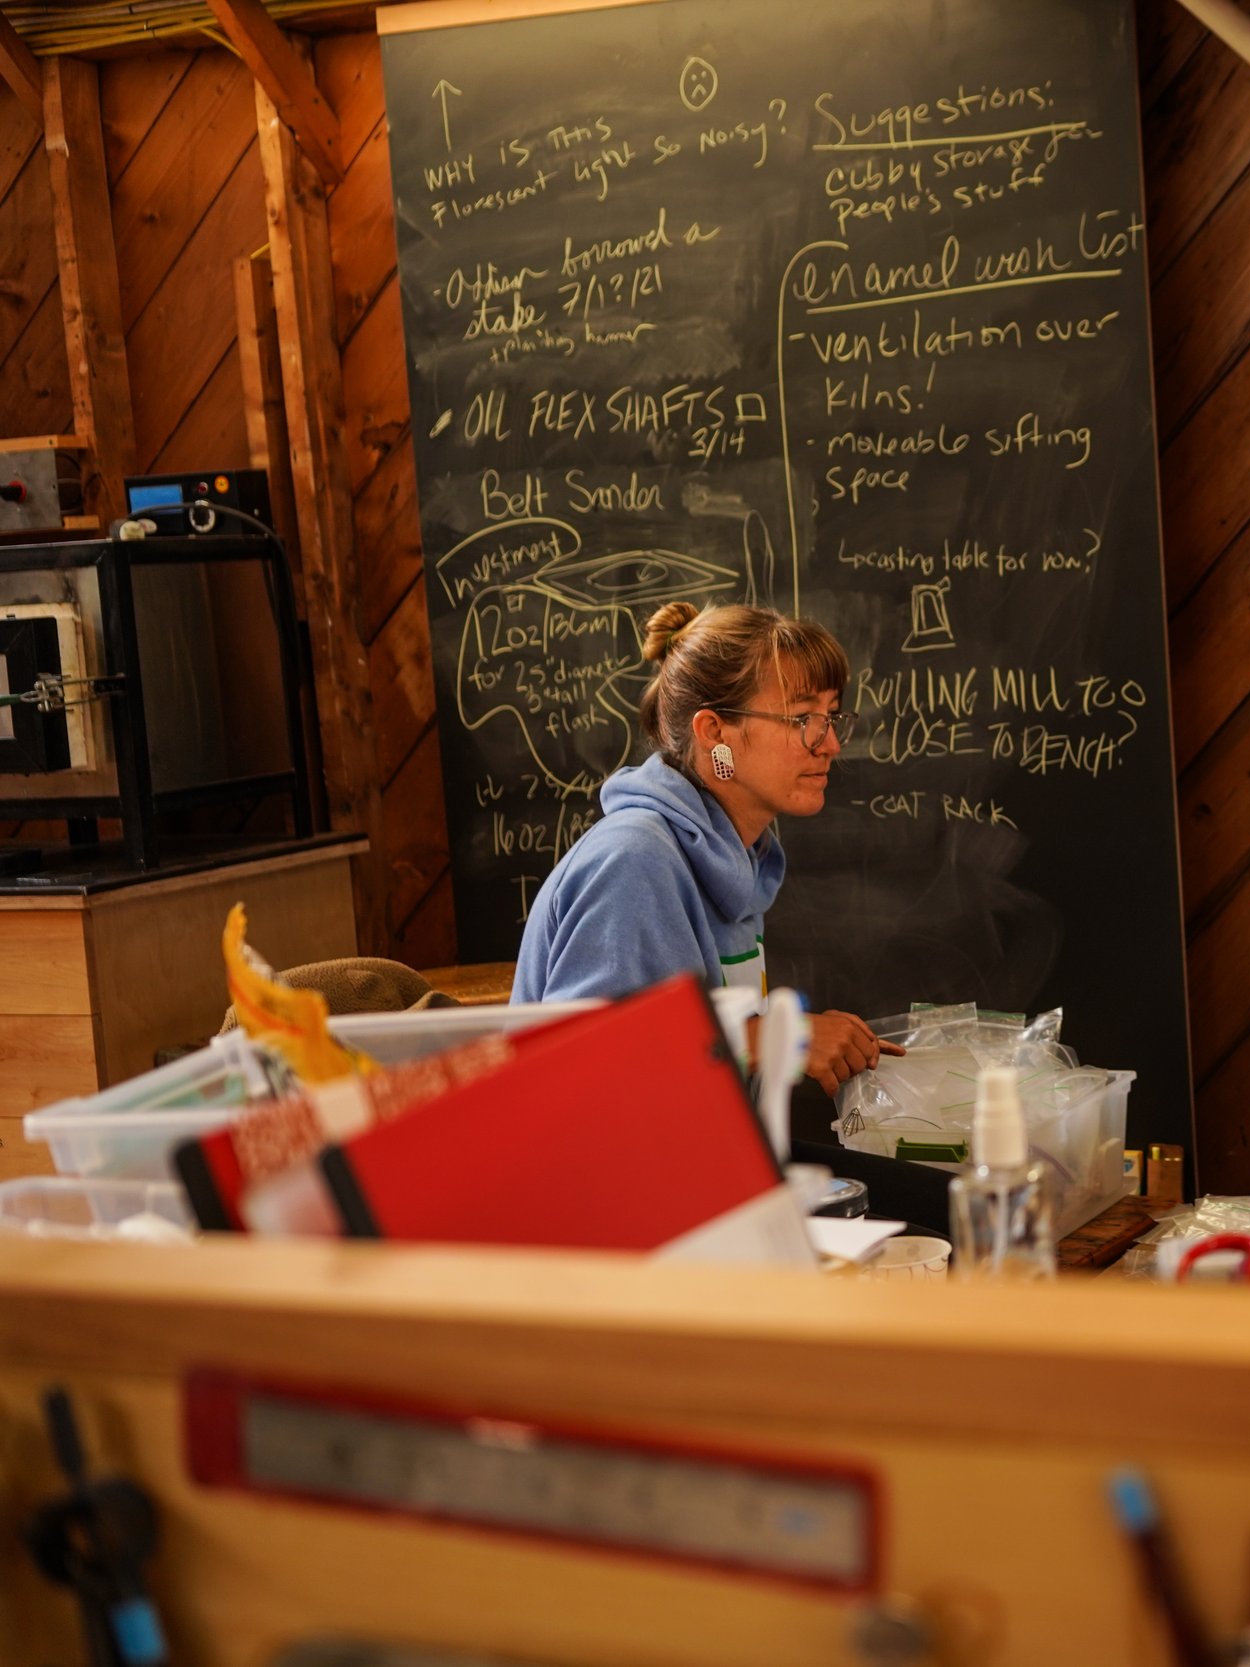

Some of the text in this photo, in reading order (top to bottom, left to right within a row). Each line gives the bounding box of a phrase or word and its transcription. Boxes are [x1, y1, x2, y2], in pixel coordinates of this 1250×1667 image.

[1036, 312, 1119, 341] over
[464, 385, 726, 442] OIL FLEX SHAFTS
[481, 468, 665, 520] Belt Sander
[942, 538, 990, 572] table
[996, 543, 1028, 577] for
[855, 665, 1147, 719] ROLLING MILL TOO
[869, 708, 986, 764] CLOSE
[988, 722, 1014, 760] TO
[943, 793, 1019, 831] RACK
